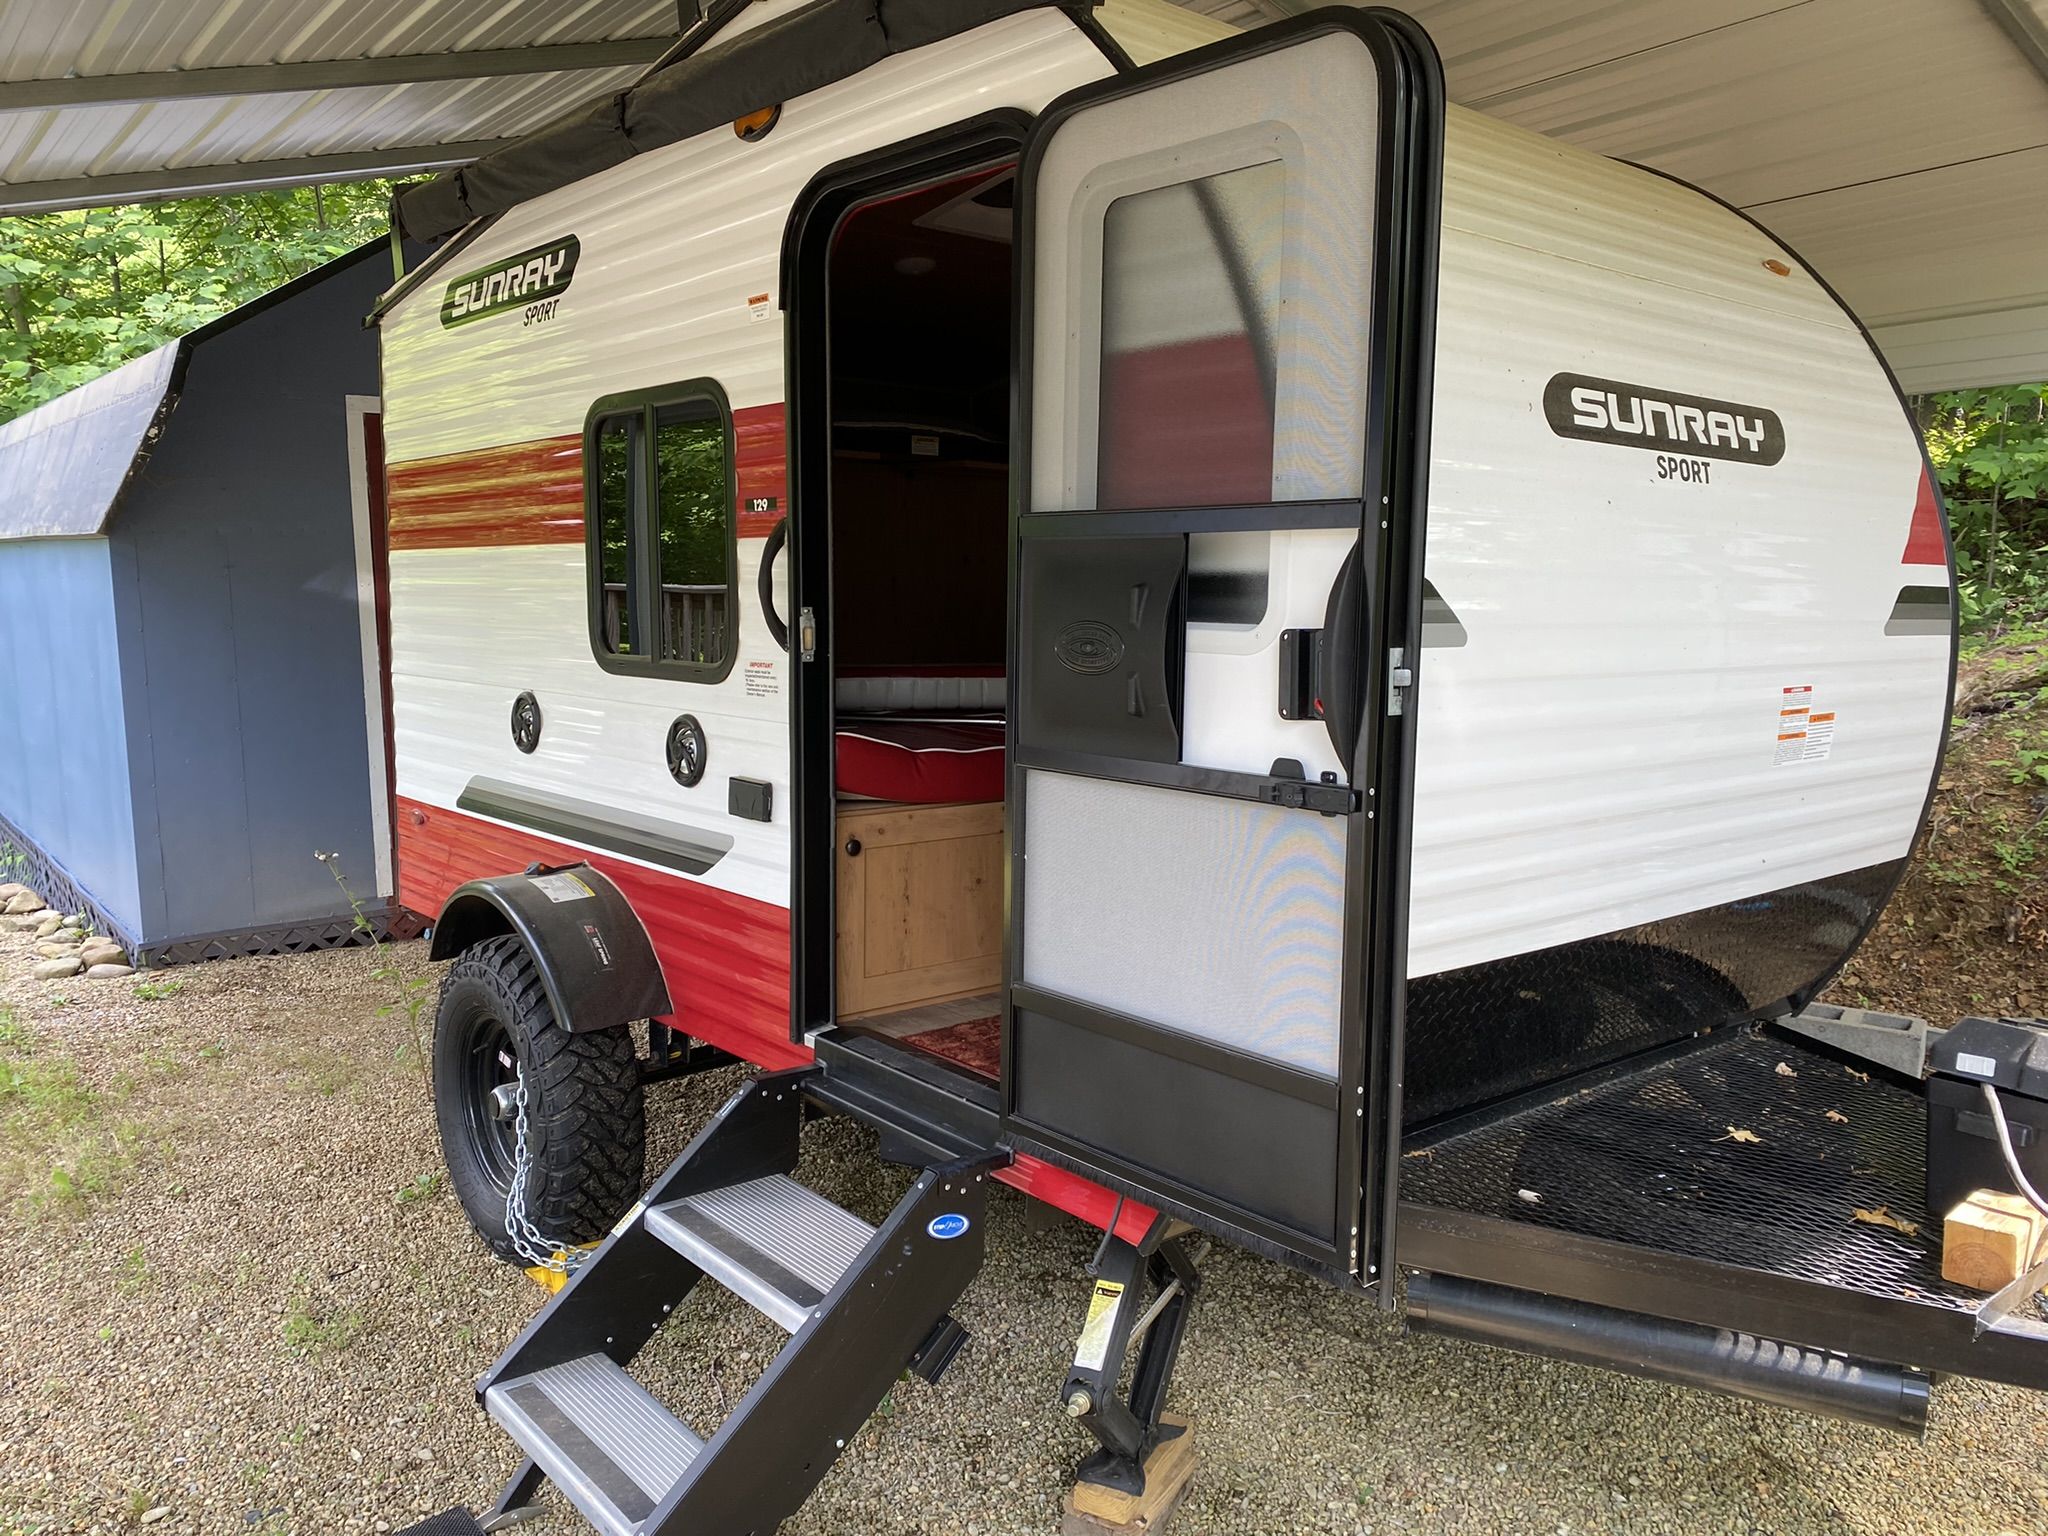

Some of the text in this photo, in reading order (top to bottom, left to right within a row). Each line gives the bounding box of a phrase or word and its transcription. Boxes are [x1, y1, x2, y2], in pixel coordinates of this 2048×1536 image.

[451, 249, 566, 318] SUNRAY
[523, 299, 560, 327] SPORT
[1571, 386, 1765, 452] SUNRAY
[1656, 455, 1711, 485] SPORT
[753, 498, 768, 512] 129
